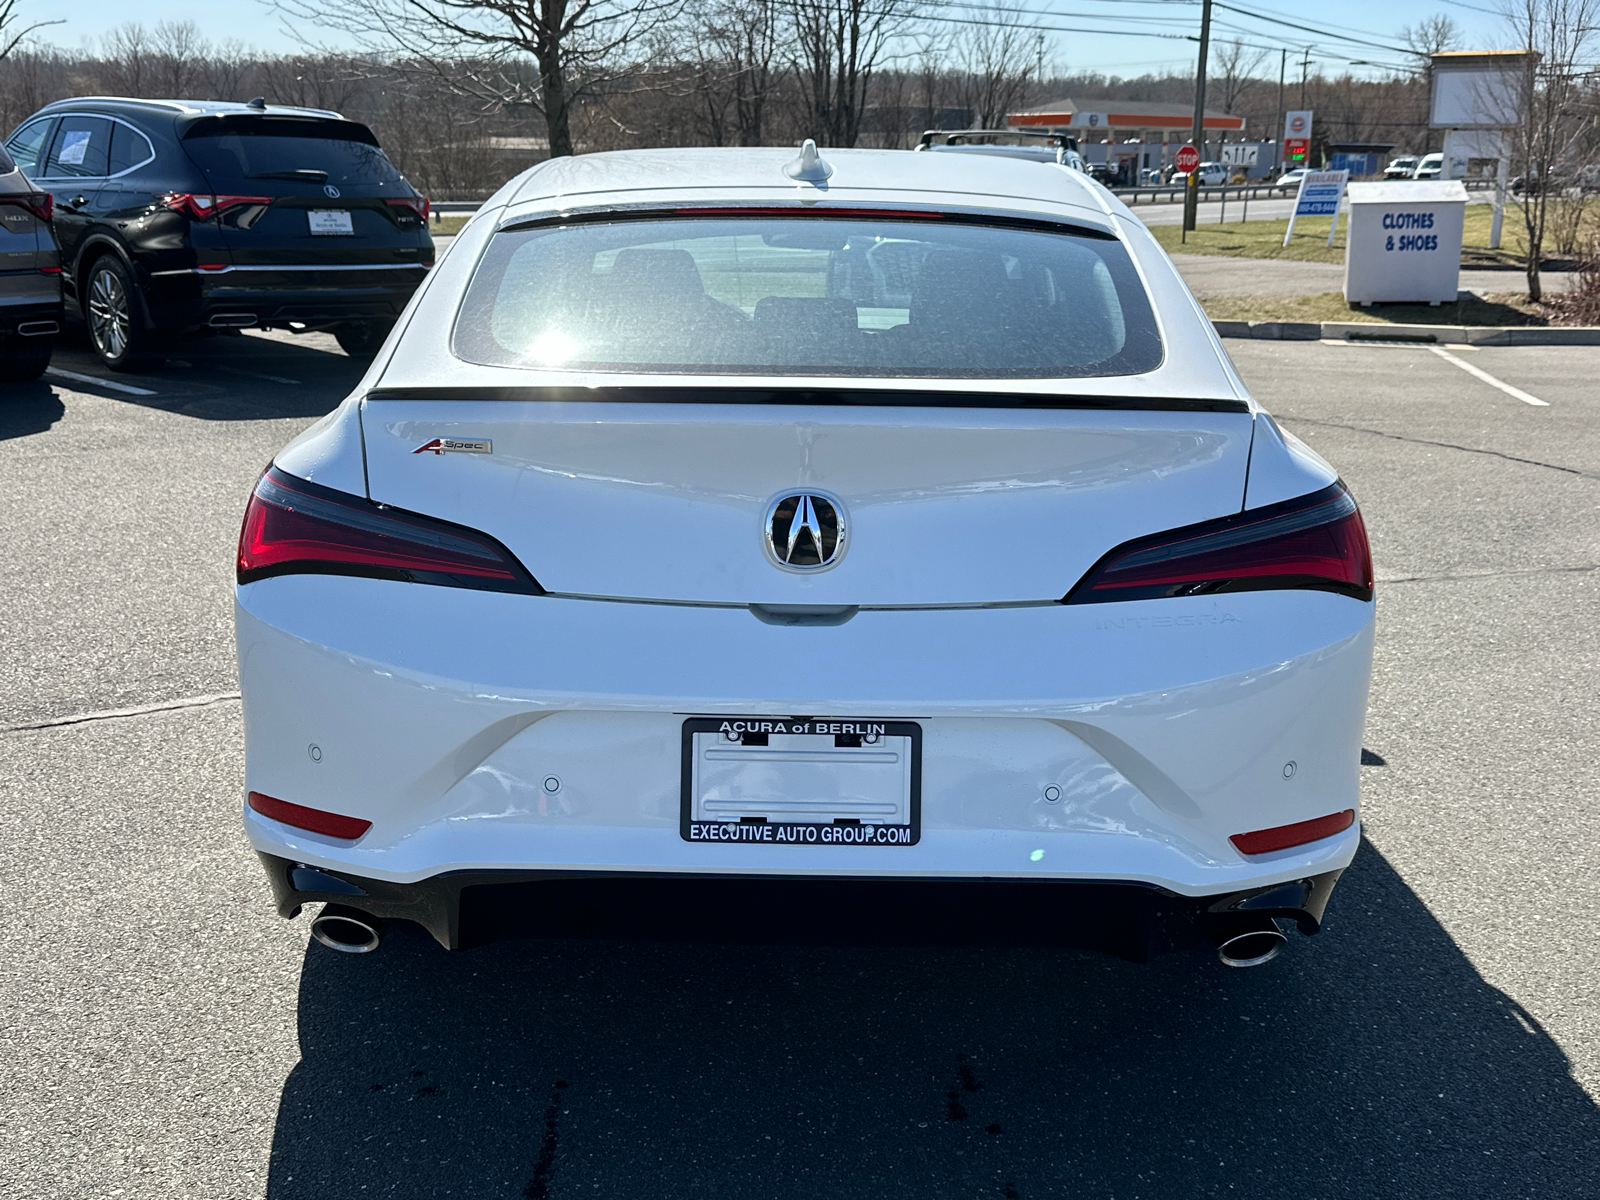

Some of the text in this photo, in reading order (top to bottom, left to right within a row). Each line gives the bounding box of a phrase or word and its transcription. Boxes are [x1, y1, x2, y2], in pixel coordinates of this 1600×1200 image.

[1176, 155, 1197, 165] STOP
[1306, 172, 1344, 183] AVAILABLE
[1382, 212, 1434, 230] CLOTHES
[1385, 234, 1438, 251] & SHOES
[444, 440, 483, 449] Spec
[1095, 612, 1242, 630] INTEGRA
[719, 721, 886, 735] ACURA of BERLIN
[690, 824, 911, 843] EXECUTIVE AUTO GROUP.COM
